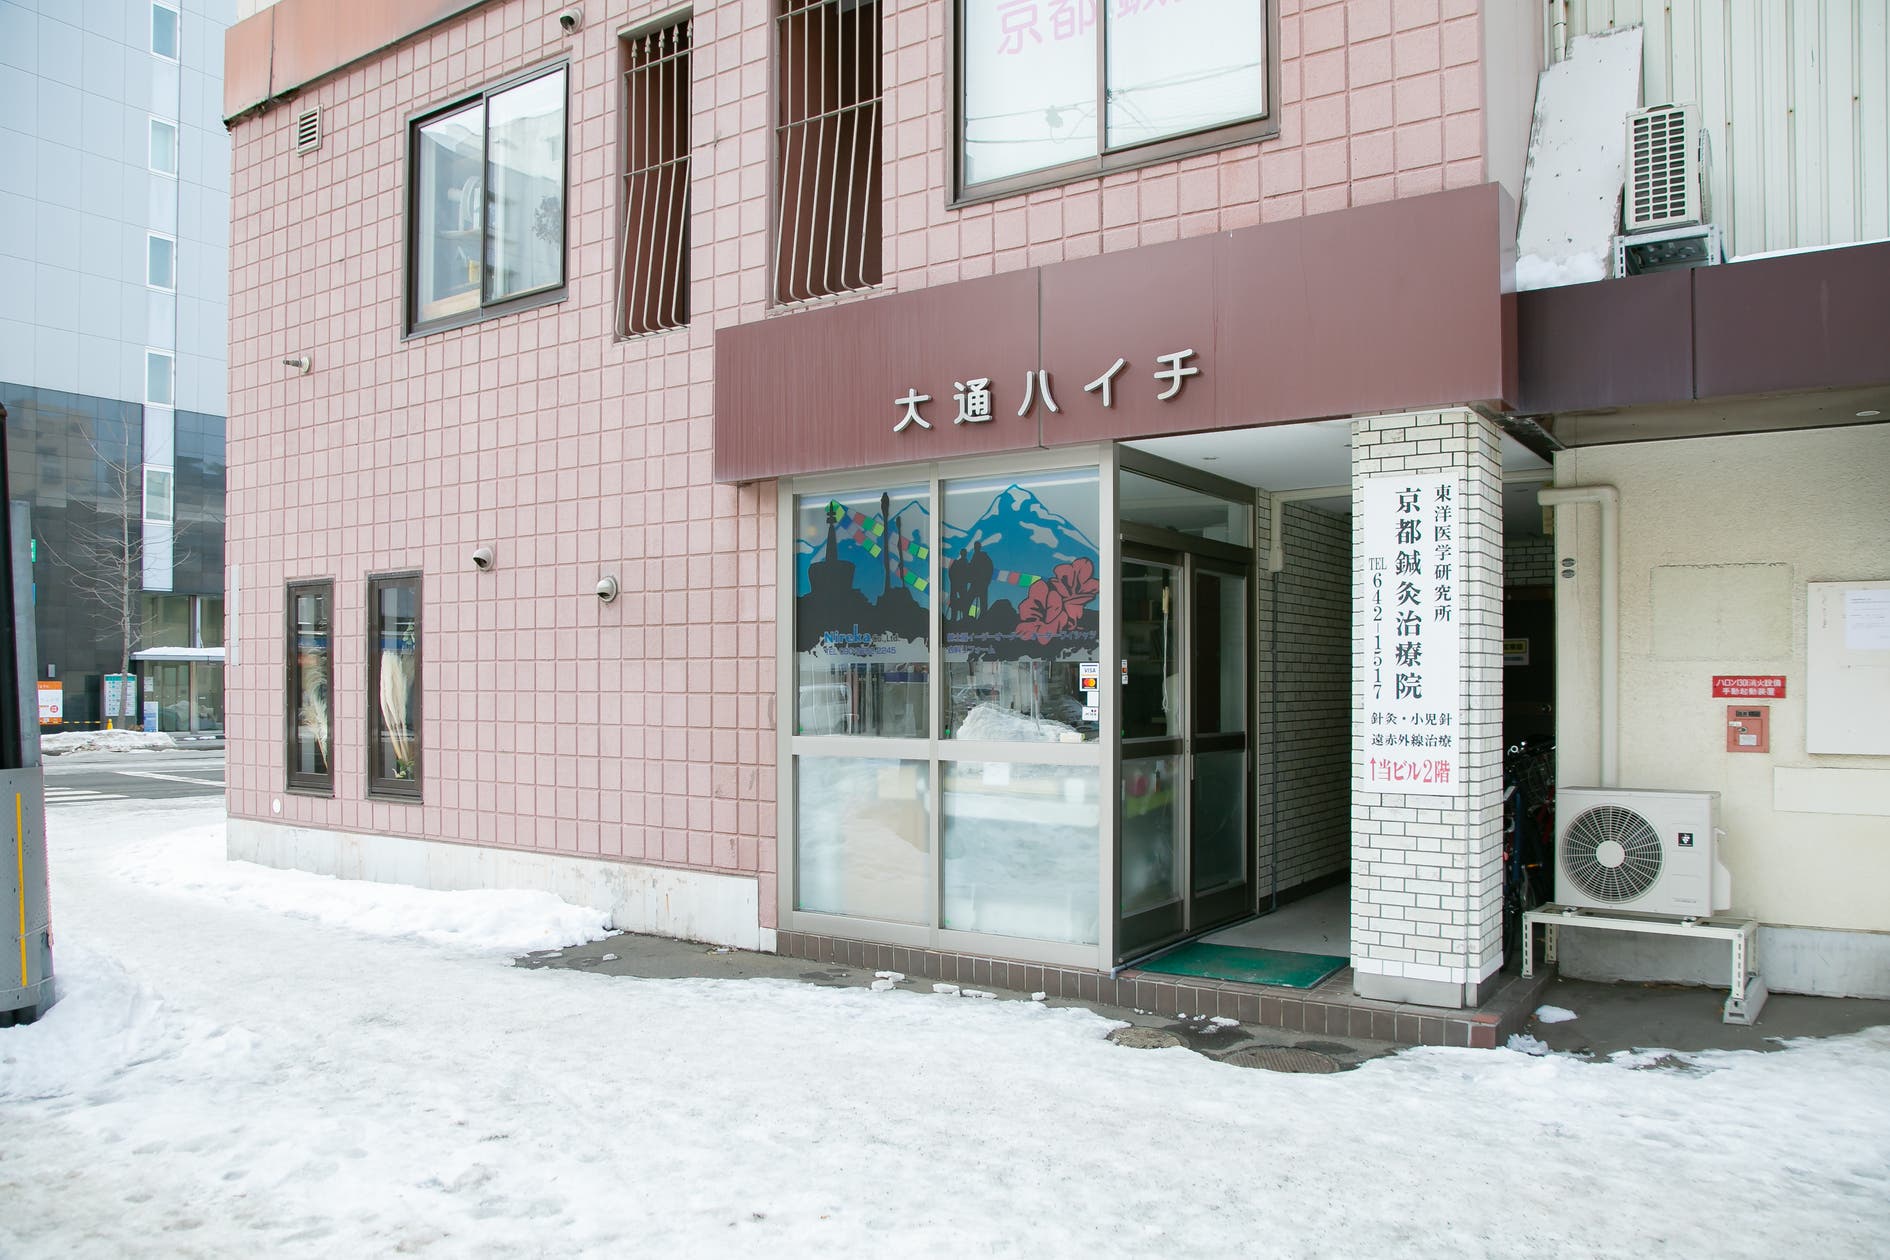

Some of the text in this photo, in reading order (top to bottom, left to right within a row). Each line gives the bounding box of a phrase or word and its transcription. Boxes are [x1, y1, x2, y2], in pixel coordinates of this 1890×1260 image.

[893, 348, 1200, 433] 大通ハイチ
[1369, 557, 1387, 571] TEL
[1434, 484, 1452, 622] 東洋医学研究所
[1395, 487, 1423, 700] 京都鍼灸治療院
[824, 624, 872, 643] Nireka
[1371, 712, 1452, 726] 針灸・小児針
[1371, 733, 1452, 748] 遠赤外線治療
[1379, 758, 1450, 784] 当ビル2階
